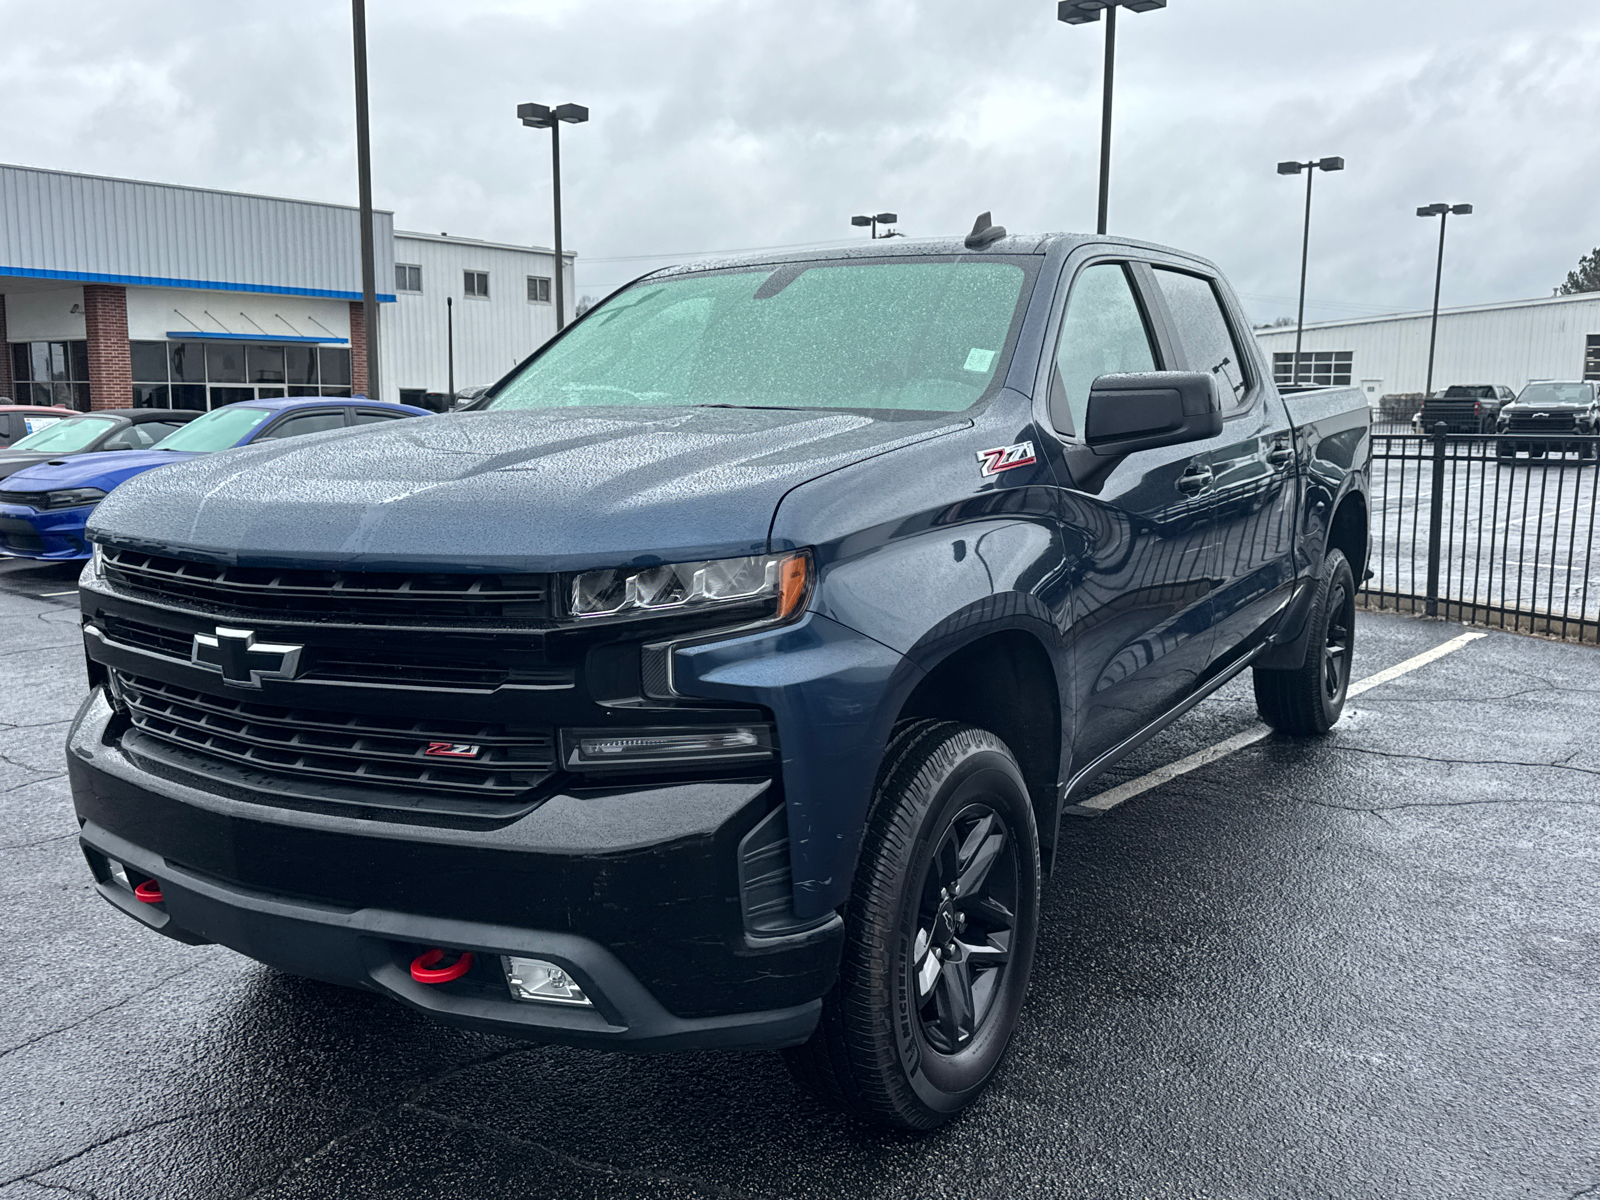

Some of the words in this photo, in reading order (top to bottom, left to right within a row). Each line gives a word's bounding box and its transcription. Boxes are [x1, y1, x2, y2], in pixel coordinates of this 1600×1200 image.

[976, 441, 1036, 478] Z71
[426, 742, 480, 757] Z71
[899, 937, 911, 1039] MICHELIN
